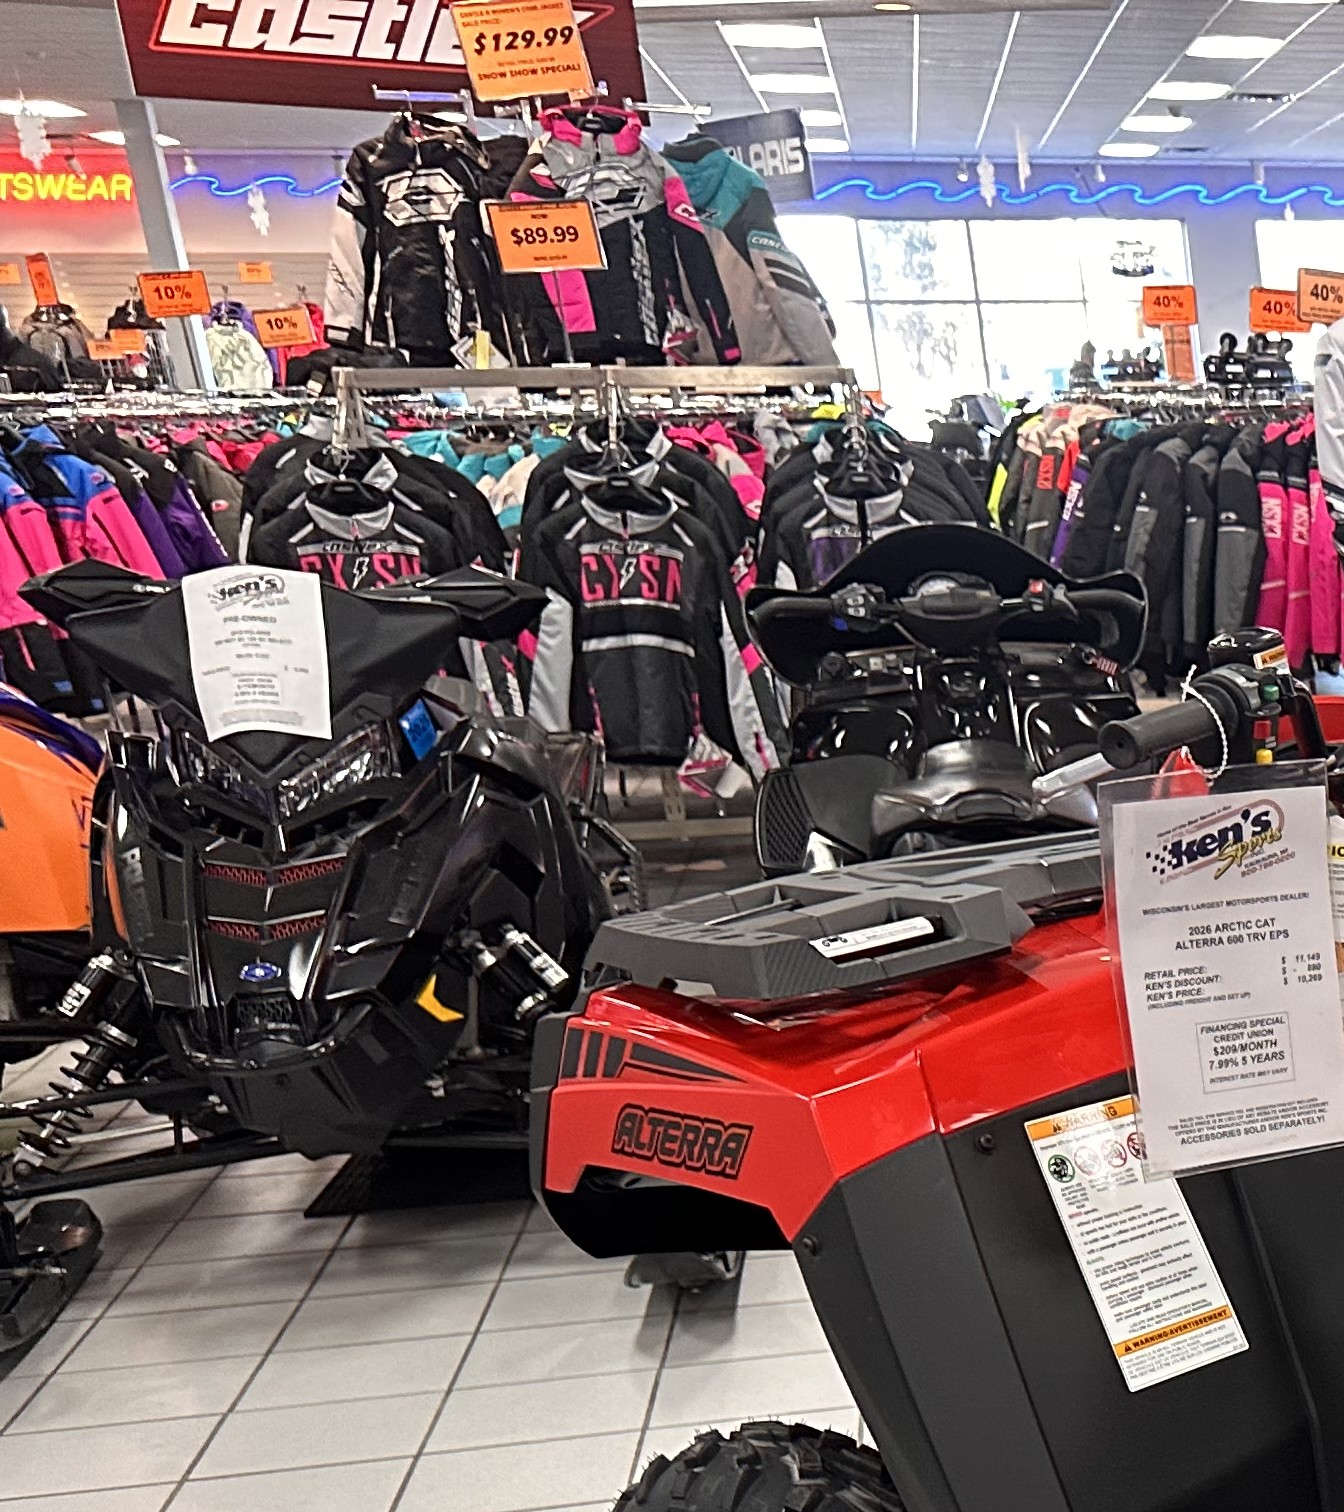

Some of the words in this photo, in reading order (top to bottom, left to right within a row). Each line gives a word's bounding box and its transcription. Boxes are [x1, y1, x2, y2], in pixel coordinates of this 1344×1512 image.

[474, 26, 573, 55] $129.99
[478, 71, 507, 81] SNOW
[510, 67, 538, 77] SHOW
[510, 226, 579, 247] $89.99
[153, 284, 192, 301] 10%
[1310, 283, 1344, 304] 40%
[1153, 295, 1184, 309] 40%
[1262, 300, 1296, 315] 40%
[266, 315, 298, 330] 10%
[1143, 905, 1190, 916] WISCONSIN'S
[1191, 900, 1225, 911] LARGEST
[1226, 895, 1279, 907] MOTORSPORTS
[1280, 892, 1310, 902] DEALER!
[1188, 925, 1212, 936] 2026
[1214, 921, 1253, 934] ARCTIC
[1255, 918, 1276, 929] CAT
[1175, 938, 1225, 951] ALTERRA
[1227, 935, 1244, 945] 600
[1247, 931, 1268, 943] TRV
[1269, 929, 1290, 940] EPS
[1144, 970, 1176, 981] RETAIL
[1178, 966, 1207, 977] PRICE:
[1295, 953, 1321, 963] 11,149
[1145, 980, 1172, 992] KEN'S
[1174, 974, 1222, 988] DISCOUNT:
[1146, 991, 1174, 1002] KEN'S
[1175, 987, 1205, 998] PRICE:
[1297, 974, 1322, 983] 10,269
[1200, 1021, 1247, 1034] FINANCING
[1250, 1016, 1285, 1028] SPECIAL
[1214, 1032, 1245, 1043] CREDIT
[1247, 1028, 1274, 1039] UNION
[1213, 1039, 1277, 1056] $209/MONTH
[1209, 1056, 1239, 1071] 7.99%
[1242, 1055, 1247, 1065] 5
[1250, 1050, 1285, 1064] YEARS
[1209, 1074, 1239, 1084] INTEREST
[1240, 1072, 1256, 1080] RATE
[1180, 1129, 1242, 1145] ACCESSORIES
[1244, 1125, 1267, 1136] SOLD
[1268, 1115, 1325, 1132] SEPARATELY!
[613, 1105, 752, 1177] ALTERRA
